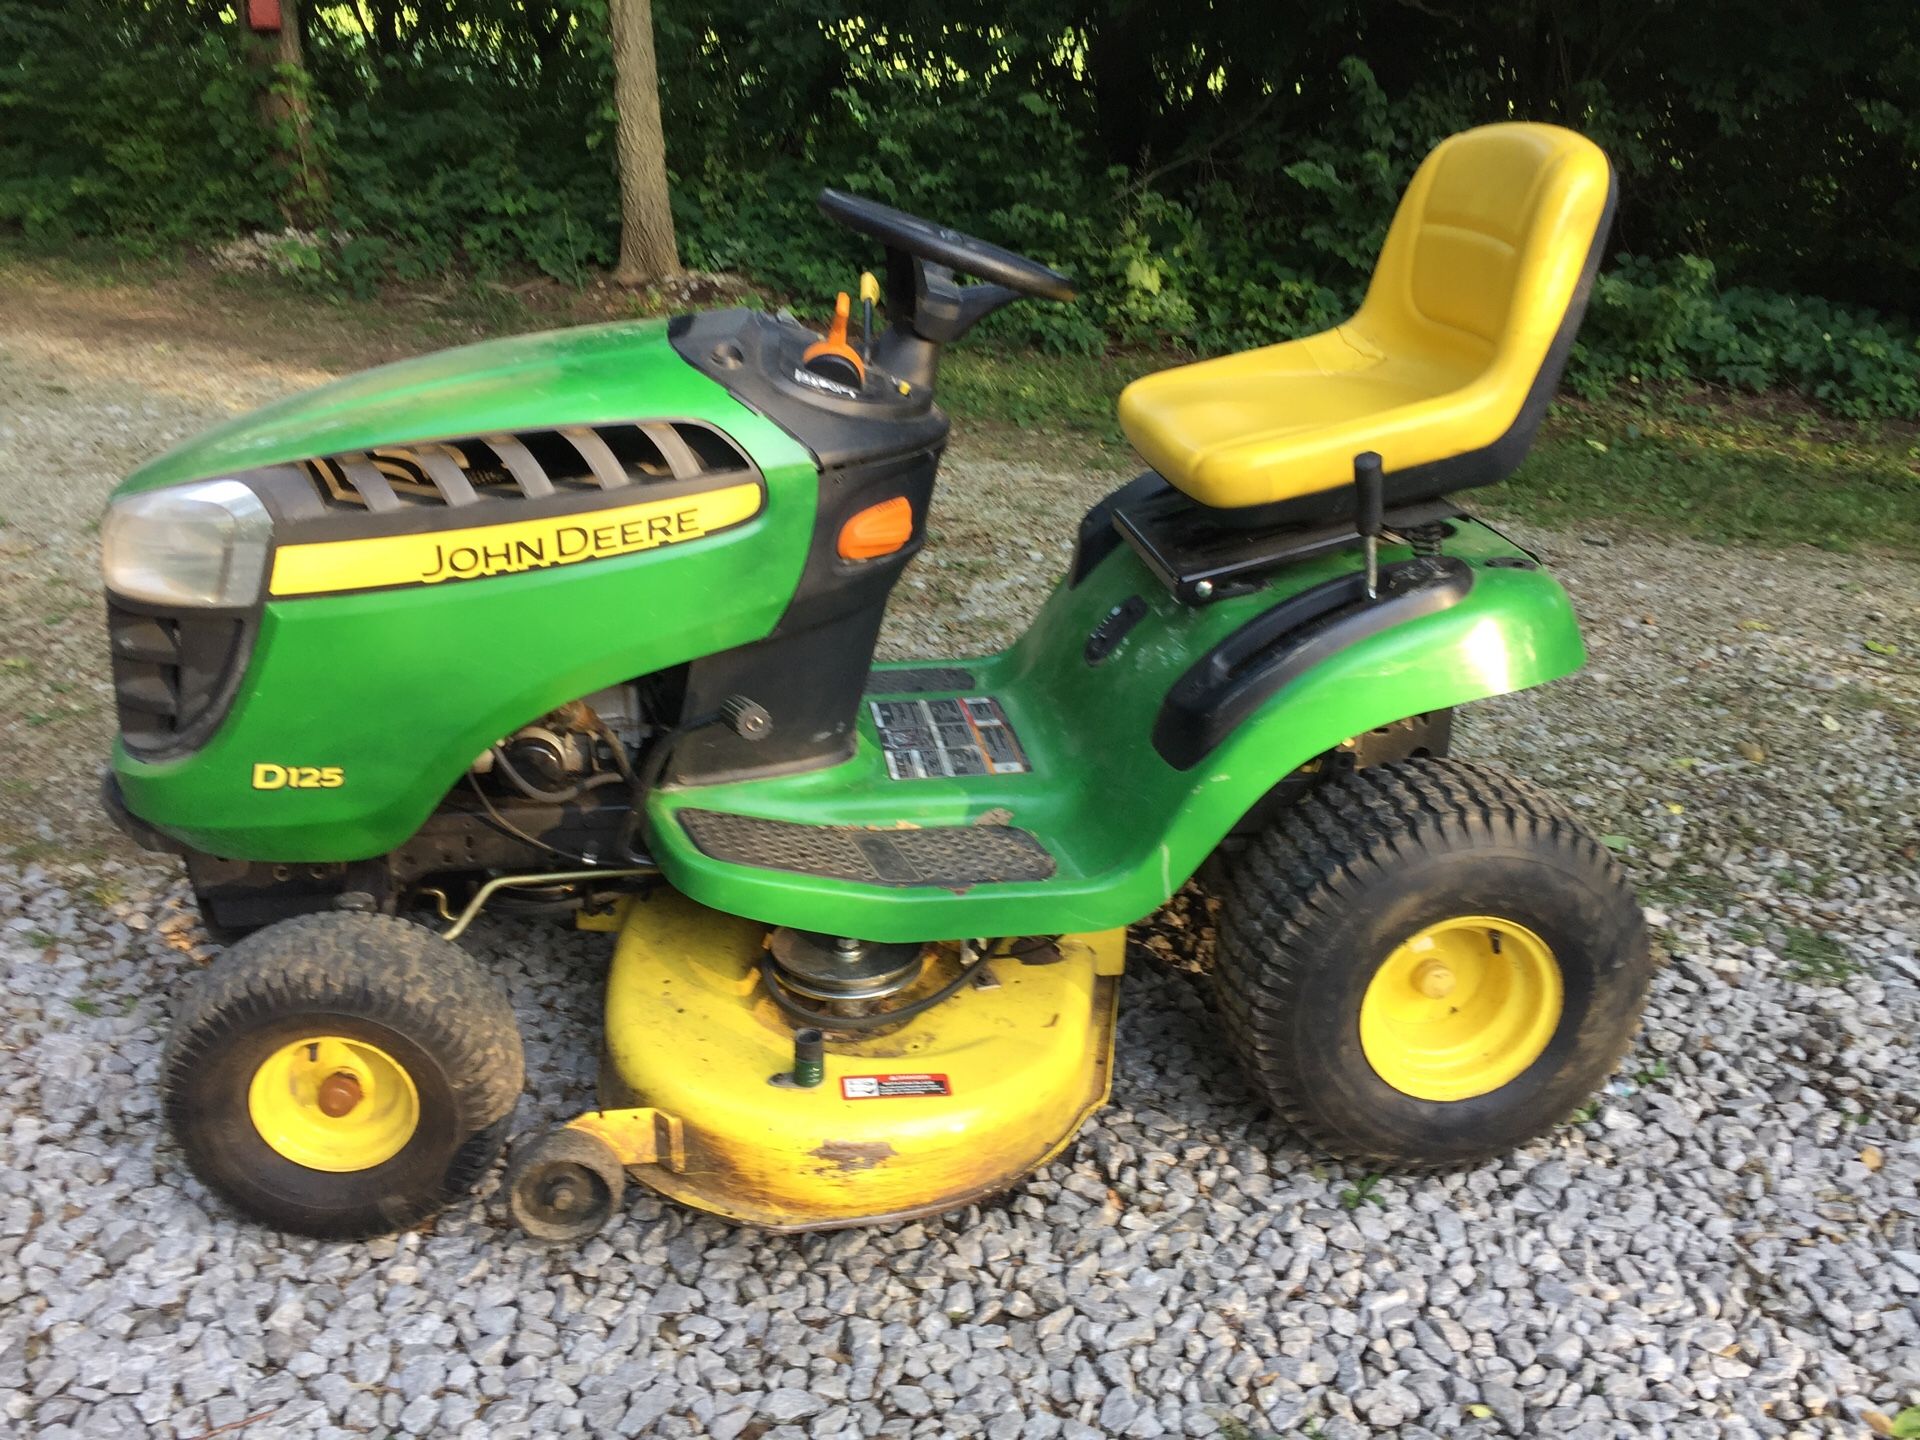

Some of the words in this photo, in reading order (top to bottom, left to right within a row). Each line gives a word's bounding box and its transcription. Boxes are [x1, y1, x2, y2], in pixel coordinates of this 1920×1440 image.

[421, 536, 546, 577] JOHN
[555, 507, 700, 558] DEERE
[252, 762, 345, 790] D125
